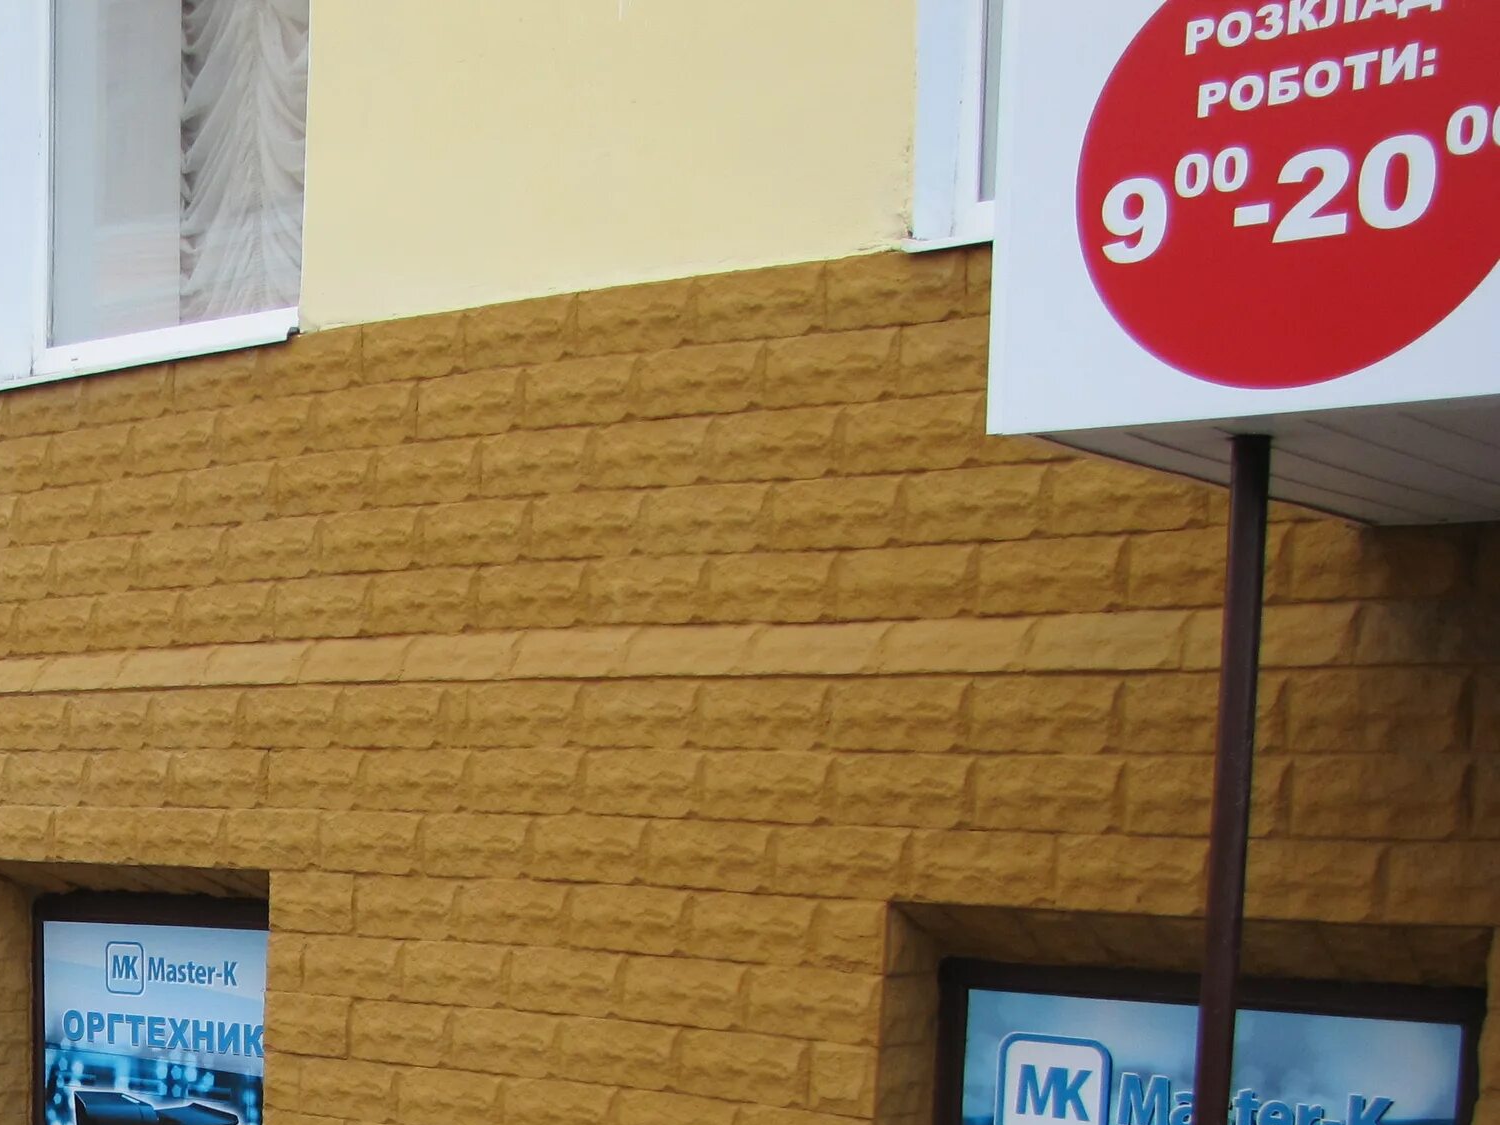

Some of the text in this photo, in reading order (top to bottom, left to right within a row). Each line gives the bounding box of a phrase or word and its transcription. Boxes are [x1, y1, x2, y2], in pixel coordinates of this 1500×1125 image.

[1197, 43, 1437, 118] РОБОТИ:
[112, 955, 238, 986] MK Master-K
[1015, 1063, 1093, 1122] MK
